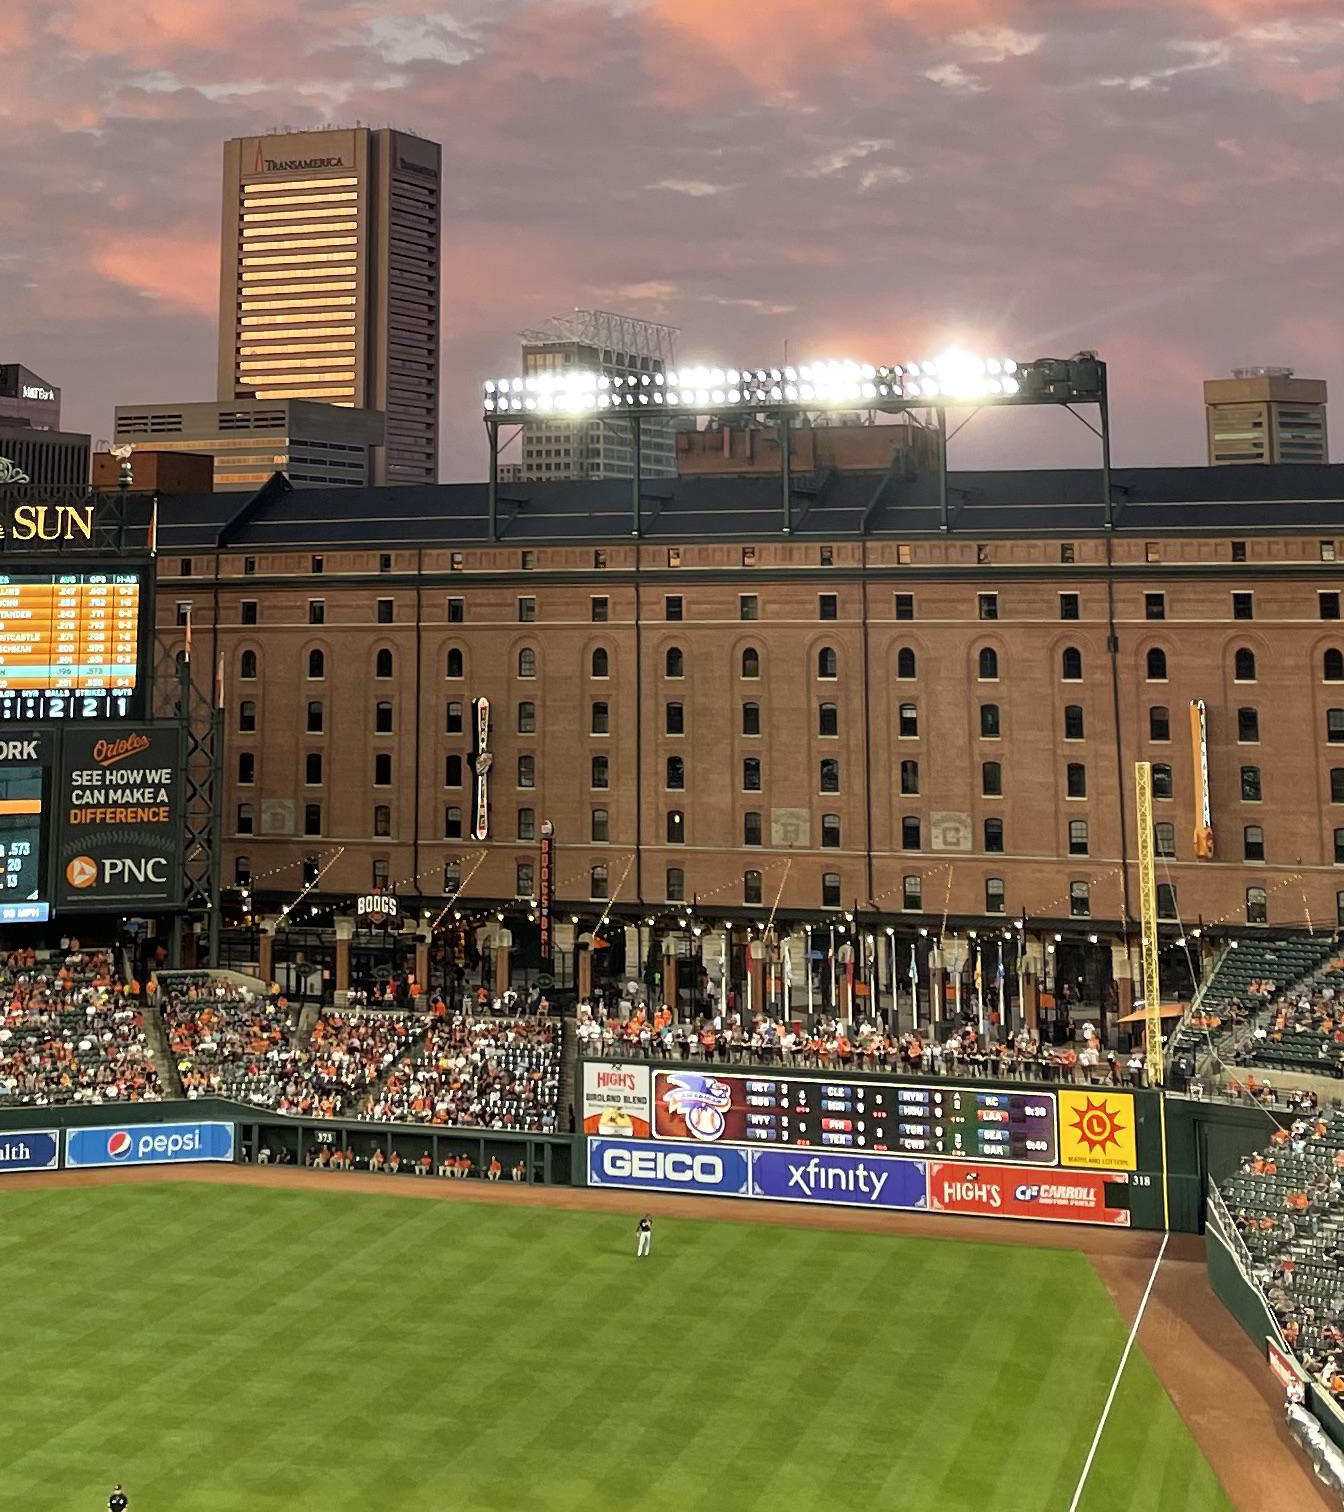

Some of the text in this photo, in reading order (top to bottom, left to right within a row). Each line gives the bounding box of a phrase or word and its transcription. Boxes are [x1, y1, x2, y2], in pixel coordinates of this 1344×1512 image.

[265, 157, 344, 171] TRANSAMERICA
[12, 505, 94, 540] SUN
[49, 698, 126, 717] 2 2 1
[93, 733, 150, 763] Orioles
[71, 769, 171, 785] SEE HOW WE
[71, 788, 168, 804] CAN MAKE A
[70, 807, 169, 824] DIFFERENCE
[8, 843, 31, 856] .573
[7, 858, 22, 871] 20
[101, 857, 167, 883] PNC
[7, 874, 17, 887] 13
[597, 1072, 636, 1090] HIGH'S
[586, 1093, 647, 1105] BIRDLAND BLEND
[827, 1086, 845, 1097] CLE
[986, 1096, 998, 1106] KC
[138, 1129, 200, 1158] pepsi
[603, 1148, 724, 1184] GEICO
[1068, 1156, 1100, 1164] MARYLAND
[788, 1158, 888, 1200] xfinity
[1132, 1176, 1151, 1187] 318
[943, 1182, 1001, 1208] HIGH'S
[1040, 1185, 1097, 1201] CARROLL
